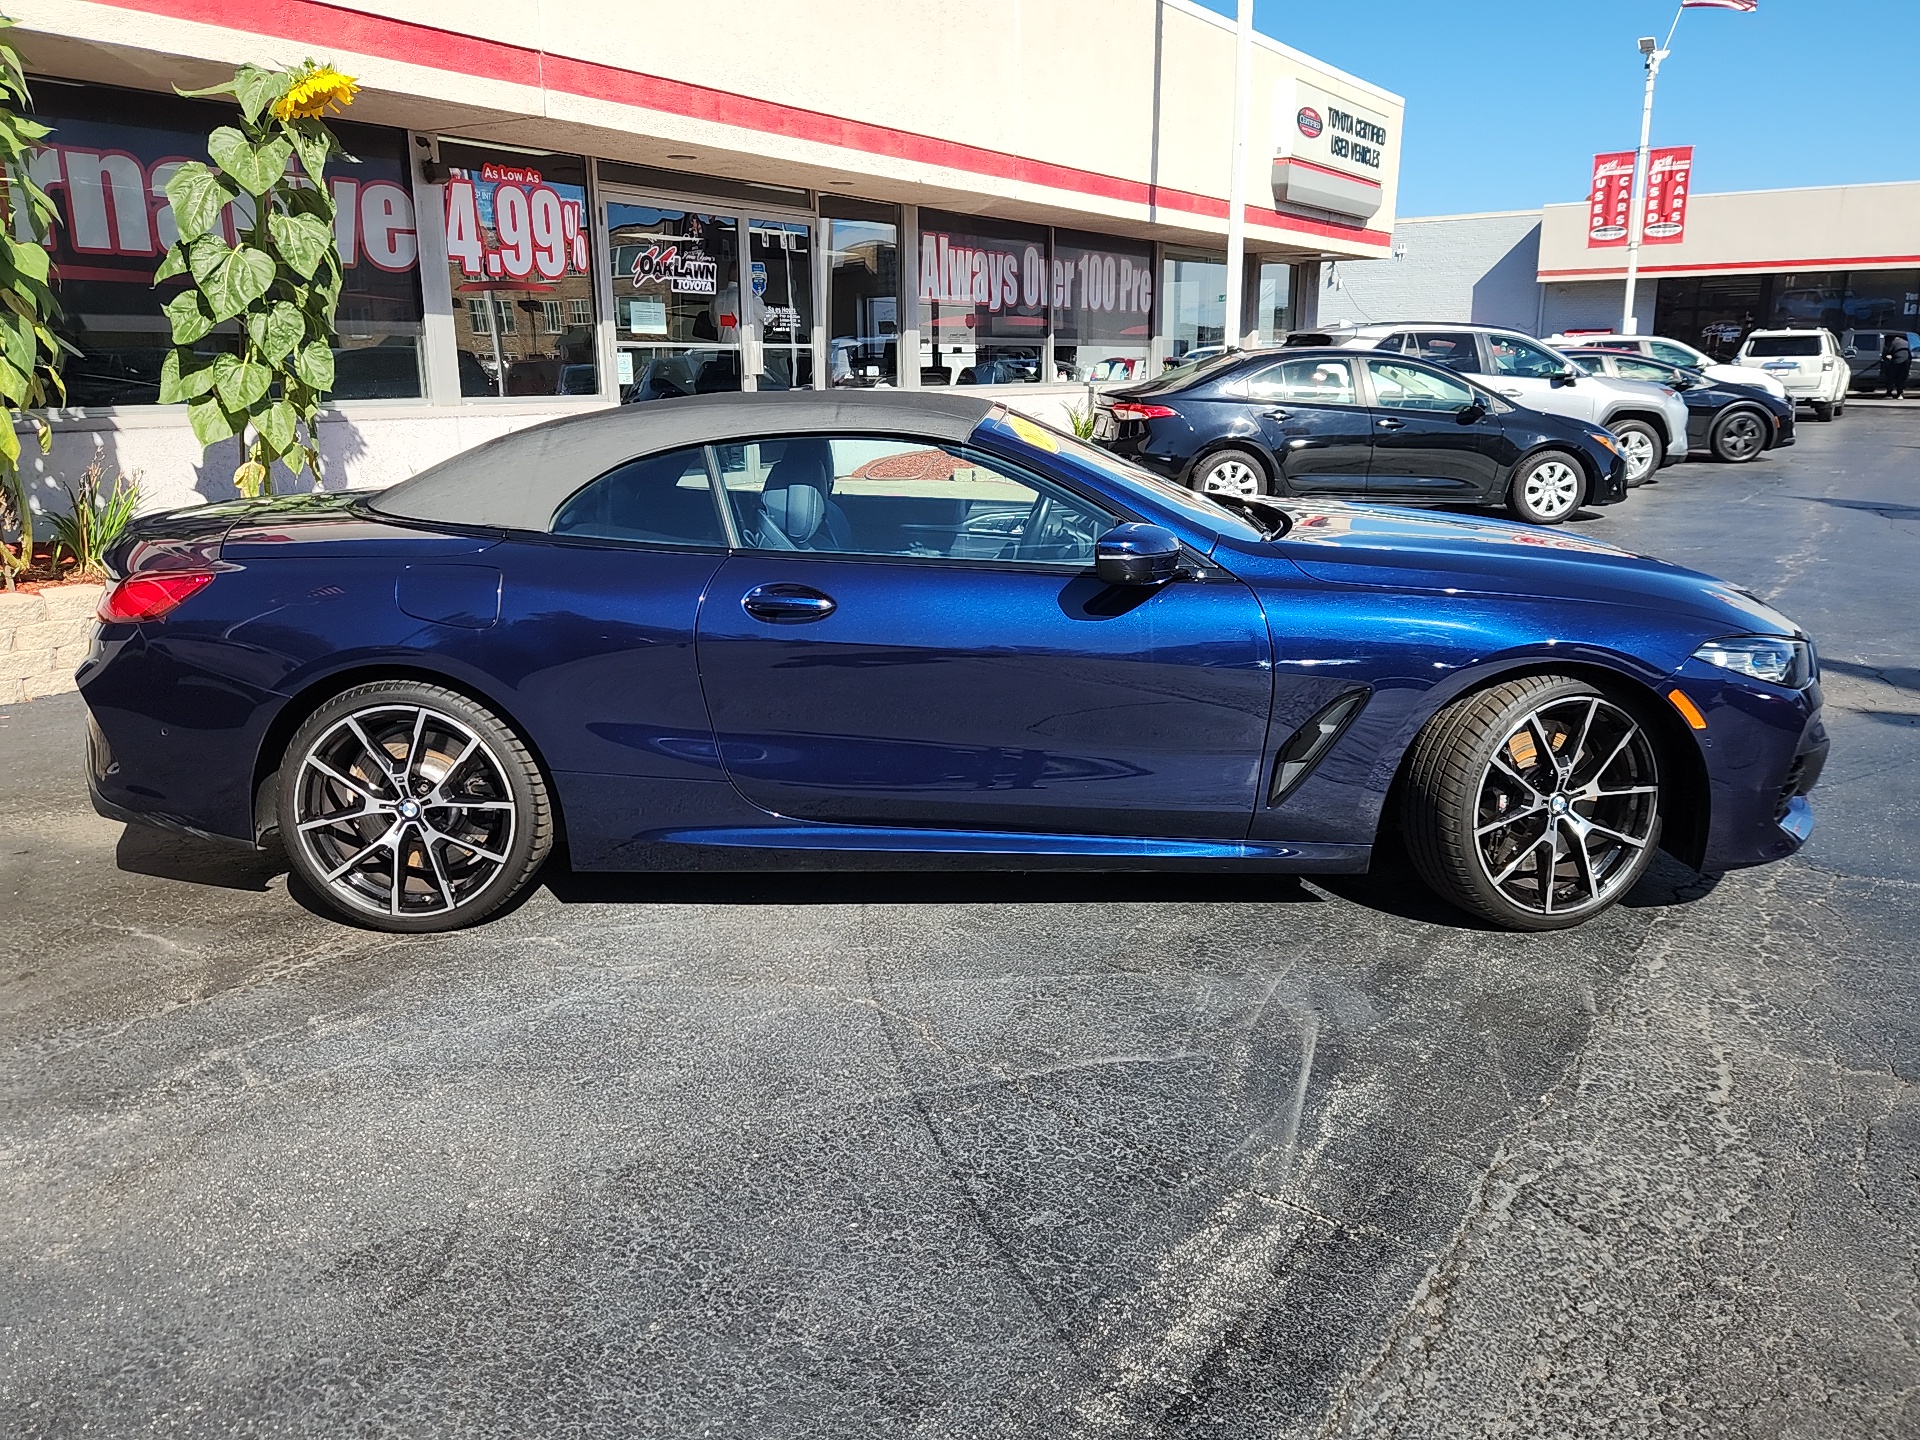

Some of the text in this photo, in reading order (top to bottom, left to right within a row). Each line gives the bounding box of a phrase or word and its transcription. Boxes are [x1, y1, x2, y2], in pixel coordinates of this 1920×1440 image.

[1327, 106, 1386, 146] TOYOTA CERTIFIED
[1330, 134, 1381, 169] USED VEHICLES
[484, 167, 540, 183] As Low As
[677, 280, 713, 291] TOYOTA
[919, 232, 1018, 311] Always
[1078, 253, 1116, 311] 100
[1120, 257, 1152, 313] Pre
